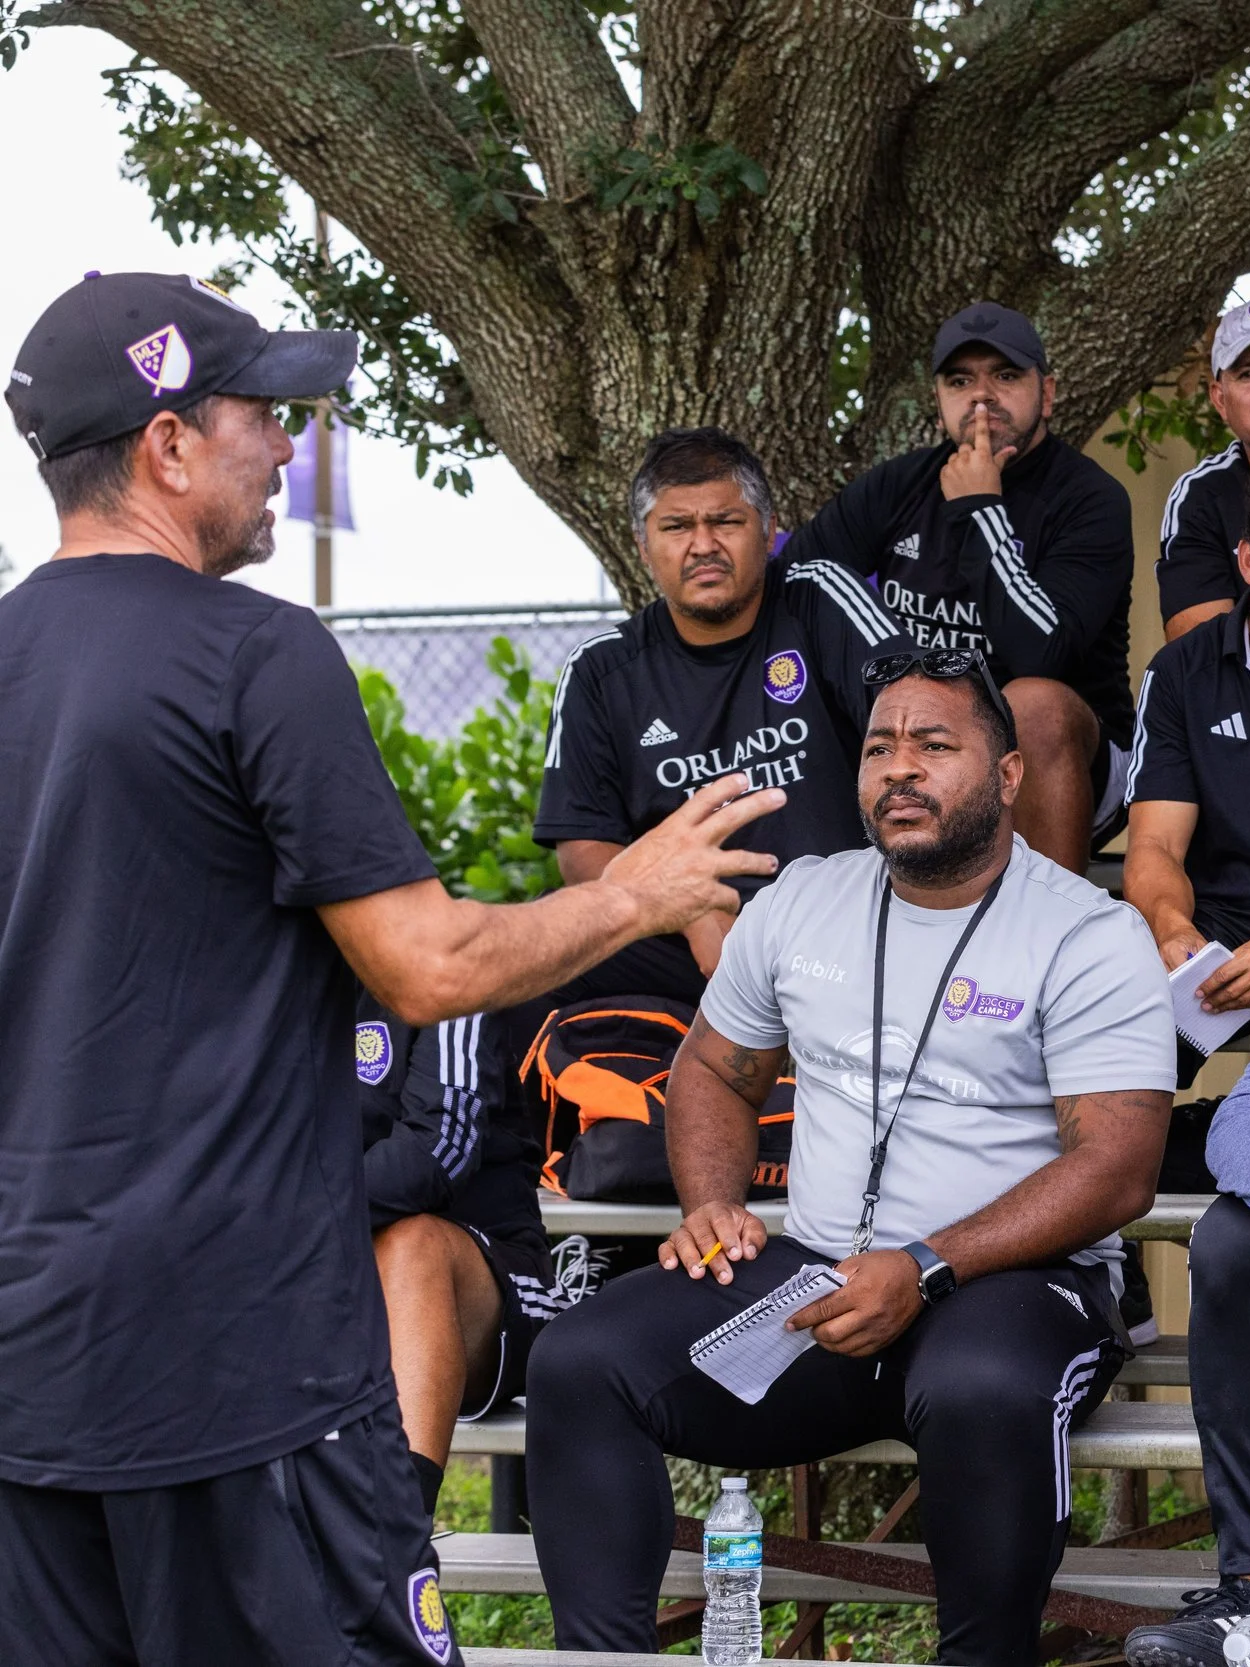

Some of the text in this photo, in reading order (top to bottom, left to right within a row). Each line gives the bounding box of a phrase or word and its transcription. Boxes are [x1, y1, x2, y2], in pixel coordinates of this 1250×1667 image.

[134, 338, 164, 363] MLS
[883, 579, 982, 627] ORLAN
[774, 683, 802, 698] ORLANDO
[782, 690, 797, 699] CITY
[640, 732, 678, 747] adidas
[656, 717, 808, 788] ORLANDO
[791, 955, 847, 984] Publix
[980, 997, 1017, 1011] SOCCER
[978, 1006, 1009, 1018] CAMPS
[357, 1063, 386, 1073] ORLANDO
[1048, 1283, 1089, 1319] adidas
